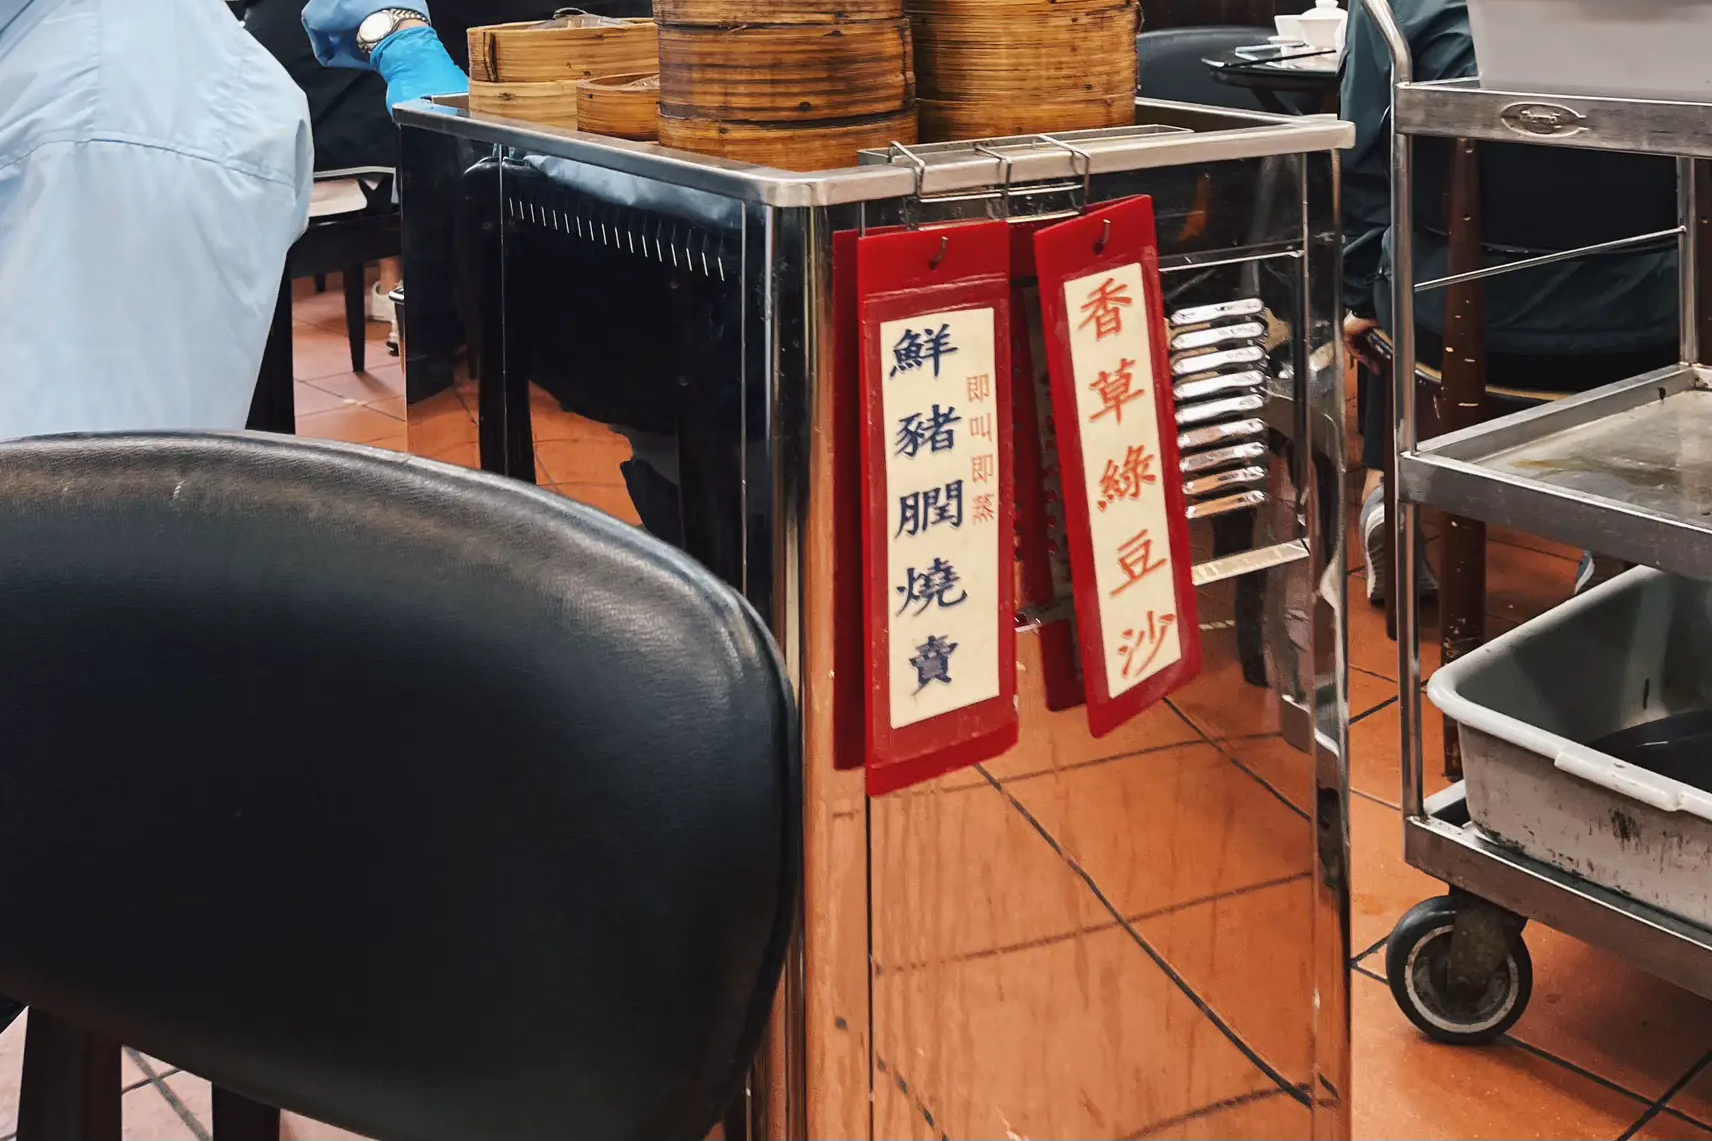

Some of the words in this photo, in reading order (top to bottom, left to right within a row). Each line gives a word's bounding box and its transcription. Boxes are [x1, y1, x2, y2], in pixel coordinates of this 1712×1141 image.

[965, 373, 995, 525] 即叫即蒸
[1078, 277, 1176, 679] 香草綠豆沙
